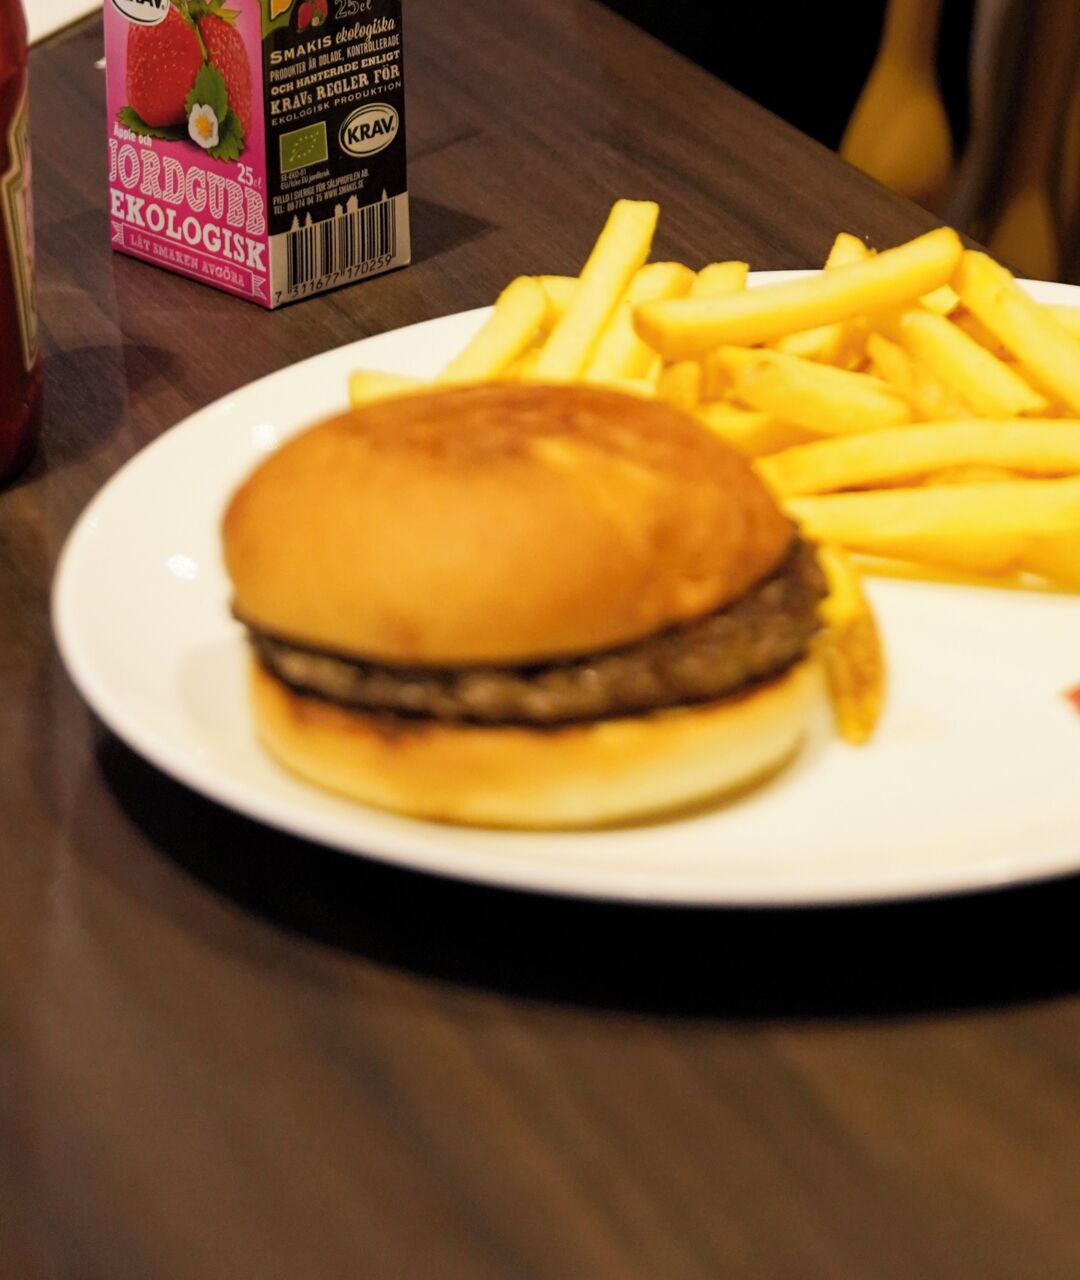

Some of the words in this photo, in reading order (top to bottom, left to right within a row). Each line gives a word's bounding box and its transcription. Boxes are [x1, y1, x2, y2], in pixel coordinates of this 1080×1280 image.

[269, 35, 332, 65] SMAKIS
[335, 16, 395, 44] ekologiska
[270, 61, 307, 82] PRODUKTER
[346, 34, 400, 58] KONTROLLERADE
[270, 91, 313, 115] KRAVs
[316, 72, 370, 100] REGLER
[374, 64, 400, 83] FÖR
[271, 82, 294, 96] OCH
[296, 62, 359, 89] HANTERADE
[361, 50, 400, 69] ENLIGT
[271, 101, 331, 126] EKOLOGISK
[334, 81, 401, 106] PRODUKTION
[138, 133, 153, 147] och
[347, 115, 394, 145] KRAV
[110, 187, 267, 272] EKOLOGISK
[129, 232, 151, 251] LÅT
[152, 242, 199, 269] SMAKEN
[201, 261, 245, 287] AVGÖRA
[291, 272, 340, 297] 311677
[346, 254, 392, 279] 170259
